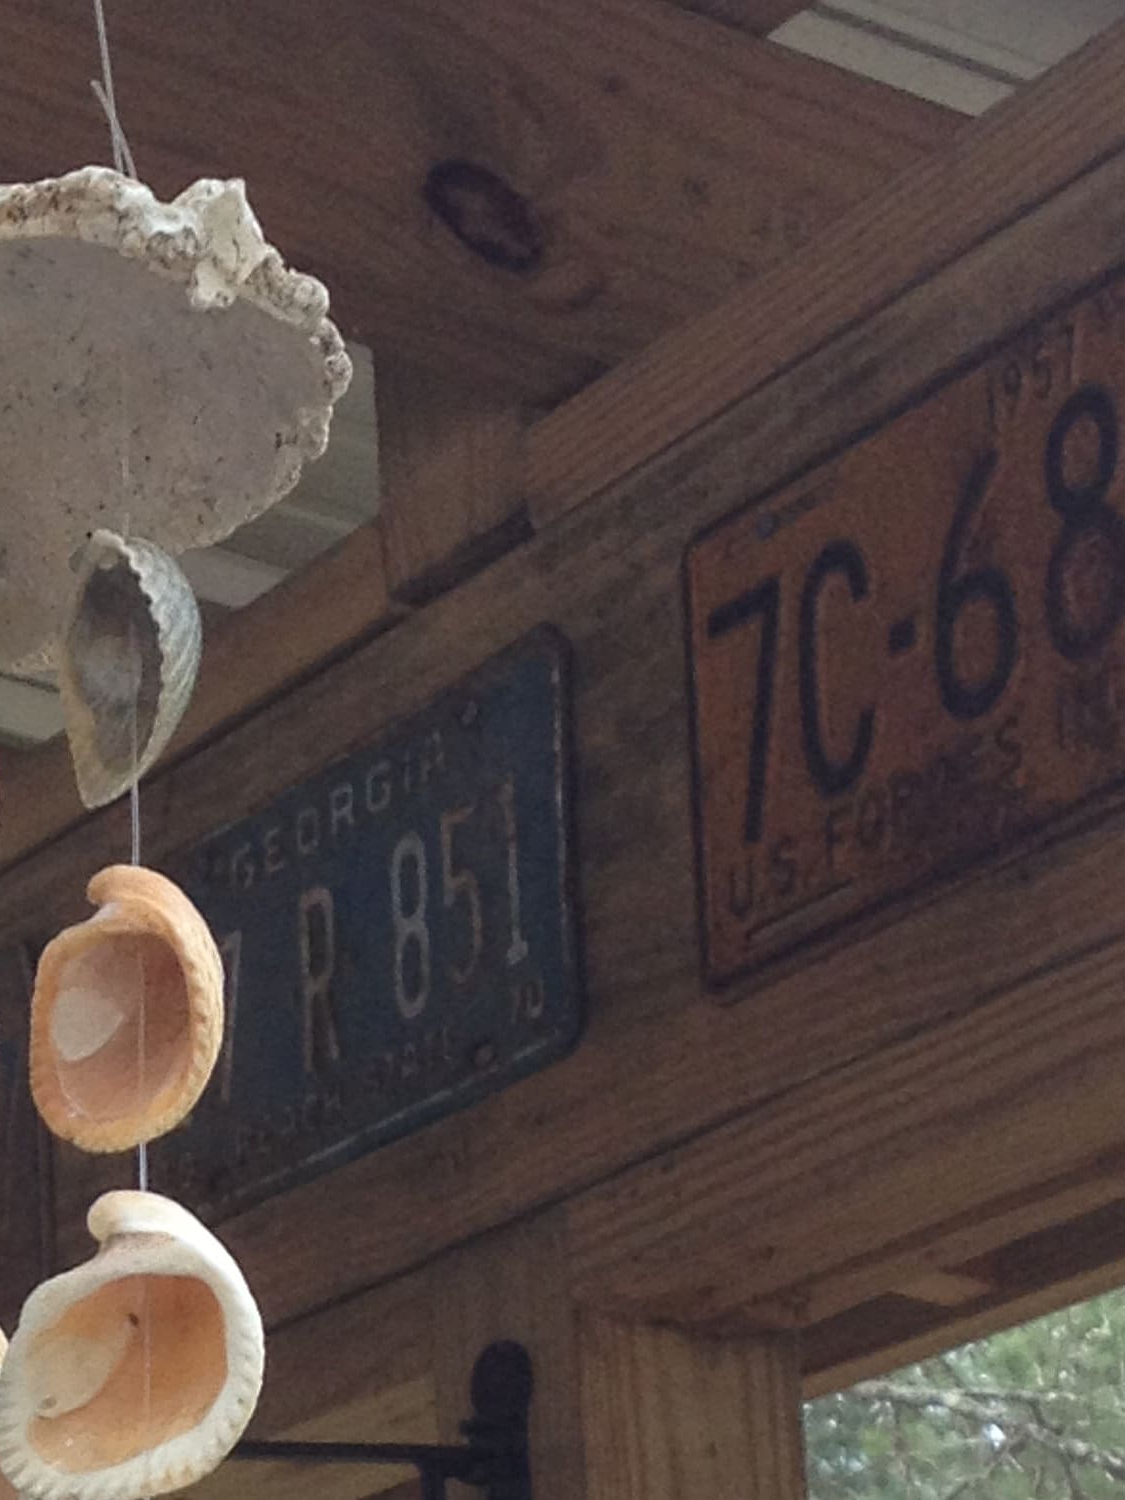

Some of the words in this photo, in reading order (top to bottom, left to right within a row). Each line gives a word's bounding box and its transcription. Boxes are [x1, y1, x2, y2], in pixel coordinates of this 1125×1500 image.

[228, 731, 447, 891] GEORGIA
[298, 885, 340, 1078] R
[389, 771, 529, 1020] 851
